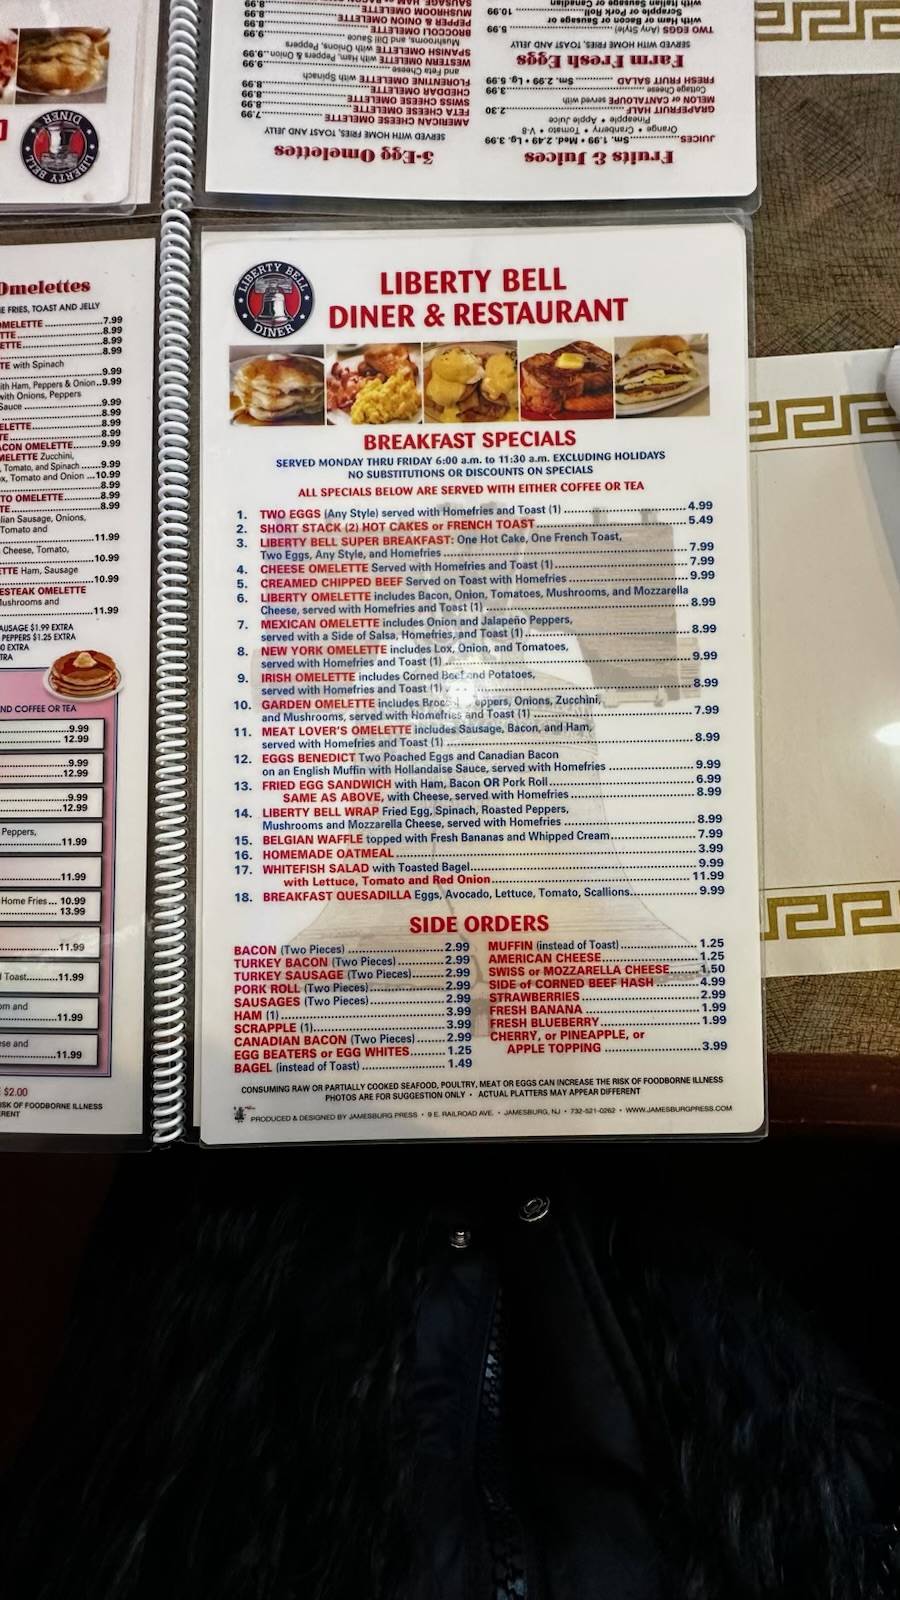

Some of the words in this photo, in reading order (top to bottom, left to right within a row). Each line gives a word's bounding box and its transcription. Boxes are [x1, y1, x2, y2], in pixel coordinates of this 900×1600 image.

[516, 52, 561, 68] Eggs
[567, 55, 624, 68] Fresh
[630, 55, 684, 68] Farm
[42, 111, 83, 125] DINER
[240, 110, 261, 119] 7.99
[325, 114, 374, 124] OMELETTE
[378, 116, 414, 125] CHEESE
[418, 118, 469, 126] AMERICAN
[522, 127, 536, 135] V-8
[548, 127, 580, 135] Tomato
[593, 125, 634, 134] Cranberry
[647, 124, 677, 134] Orange
[274, 145, 375, 163] Omelettes
[381, 146, 434, 164] 3-Egg
[524, 152, 586, 165] Juices
[592, 152, 606, 165] &
[612, 151, 673, 165] Fruits
[27, 153, 47, 180] BELL
[50, 154, 94, 183] LIBERTY
[238, 261, 284, 294] LIBERTY
[284, 265, 308, 293] BELL
[381, 270, 491, 295] LIBERTY
[503, 267, 566, 292] BELL
[8, 306, 30, 314] FRIES,
[32, 304, 57, 313] TOAST
[59, 303, 78, 311] AND
[80, 302, 100, 310] JELLY
[330, 304, 415, 328] DINER
[424, 304, 445, 327] &
[454, 298, 628, 326] RESTAURANT
[253, 321, 295, 337] DINER
[13, 361, 30, 369] with
[32, 360, 64, 369] Spinach
[17, 391, 47, 400] Onions,
[50, 390, 82, 399] Peppers
[364, 432, 476, 450] BREAKFAST
[482, 430, 576, 448] SPECIALS
[276, 459, 316, 468] SERVED
[319, 458, 363, 467] MONDAY
[367, 458, 394, 466] THRU
[397, 457, 432, 466] FRIDAY
[436, 456, 458, 464] 6:00
[485, 456, 495, 464] to
[499, 454, 526, 463] 11:30
[553, 452, 611, 462] EXCLUDING
[615, 450, 665, 460] HOLIDAYS
[11, 474, 41, 482] Tomato
[43, 473, 58, 481] and
[60, 472, 84, 480] Onion
[348, 470, 364, 479] NO
[367, 469, 445, 478] SUBSTITUTIONS
[448, 468, 462, 477] OR
[466, 467, 524, 476] DISCOUNTS
[527, 467, 542, 475] ON
[545, 465, 594, 475] SPECIALS
[298, 488, 317, 497] ALL
[321, 487, 372, 497] SPECIALS
[376, 487, 413, 496] BELOW
[416, 486, 437, 495] ARE
[441, 485, 484, 495] SERVED
[487, 484, 515, 493] WITH
[519, 483, 557, 493] EITHER
[560, 482, 601, 492] COFFEE
[604, 482, 621, 491] OR
[624, 481, 644, 491] TEA
[237, 510, 247, 519] 1.
[260, 510, 286, 519] TWO
[290, 509, 320, 519] EGGS
[324, 509, 347, 519] (Any
[350, 508, 378, 519] Style)
[382, 508, 414, 517] served
[417, 508, 440, 517] with
[443, 506, 494, 516] Homefries
[497, 506, 515, 515] and
[518, 505, 546, 514] Toast
[549, 505, 561, 515] (1)
[688, 502, 713, 510] 4.99
[17, 514, 54, 524] Sausage,
[56, 513, 87, 522] Onions,
[237, 525, 247, 533] 2.
[260, 523, 298, 533] SHORT
[302, 523, 342, 533] STACK
[345, 522, 359, 533] (2)
[362, 522, 386, 531] HOT
[389, 521, 429, 531] CAKES
[432, 523, 443, 531] or
[447, 520, 492, 530] FRENCH
[497, 519, 535, 529] TOAST
[688, 516, 713, 524] 5.49
[2, 633, 31, 642] PEPPERS
[33, 633, 52, 641] $1.25
[54, 632, 76, 641] EXTRA
[15, 705, 46, 713] COFFEE
[62, 704, 77, 712] TEA
[64, 735, 89, 743] 12.99
[234, 781, 252, 791] 13.
[262, 781, 295, 790] FRIED
[300, 780, 324, 790] EGG
[328, 779, 392, 790] SANDWICH
[394, 779, 417, 789] with
[420, 779, 447, 789] Ham,
[449, 778, 480, 788] Bacon
[483, 778, 500, 787] OR
[503, 777, 526, 787] Pork
[528, 776, 548, 786] Roll
[696, 775, 721, 783] 6.99
[1, 828, 37, 837] Peppers,
[409, 916, 458, 934] SIDE
[464, 914, 549, 933] ORDERS
[234, 945, 277, 955] BACON
[280, 945, 306, 955] (Two
[310, 944, 344, 955] Pieces)
[488, 941, 533, 951] MUFFIN
[536, 940, 574, 951] (instead
[577, 940, 587, 950] of
[590, 939, 619, 950] Toast)
[700, 938, 724, 948] 1.25
[490, 1005, 527, 1015] FRESH
[530, 1004, 583, 1014] BANANA
[702, 1002, 726, 1012] 1.99
[241, 1085, 290, 1094] CONSUMING
[292, 1084, 310, 1093] RAW
[312, 1084, 323, 1092] OR
[325, 1083, 365, 1092] PARTIALLY
[367, 1082, 399, 1091] COOKED
[401, 1082, 439, 1091] SEAFOOD,
[441, 1081, 479, 1090] POULTRY,
[480, 1080, 501, 1088] MEAT
[515, 1079, 537, 1087] EGGS
[538, 1079, 555, 1087] CAN
[557, 1078, 594, 1086] INCREASE
[630, 1077, 642, 1085] OF
[644, 1077, 691, 1085] FOODBORNE
[692, 1076, 724, 1084] ILLNESS
[4, 1088, 28, 1097] $2.00
